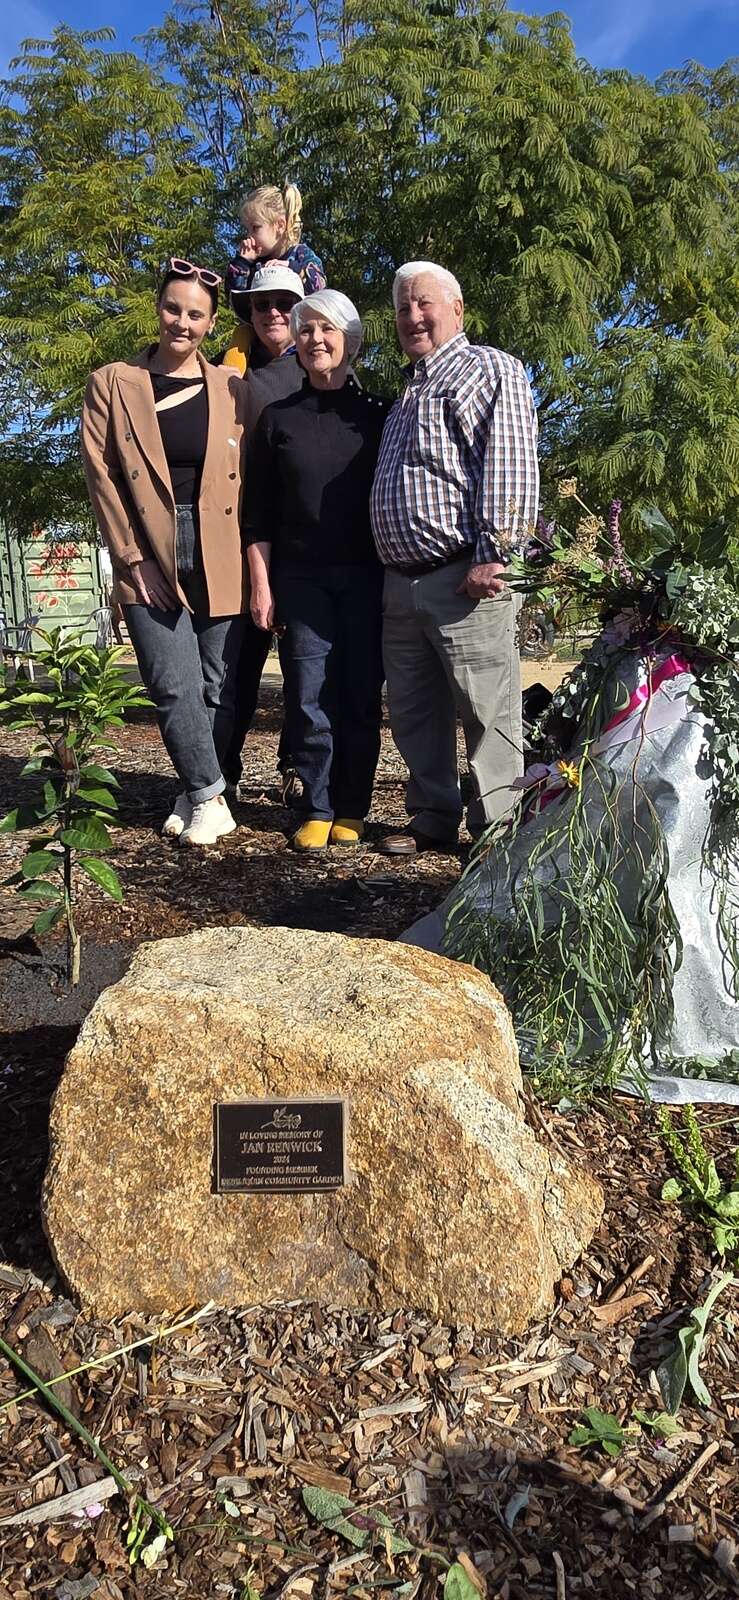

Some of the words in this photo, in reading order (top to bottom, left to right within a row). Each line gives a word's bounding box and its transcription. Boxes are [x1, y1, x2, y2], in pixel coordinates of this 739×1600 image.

[240, 1131, 248, 1140] IN
[249, 1130, 278, 1140] LOVING
[278, 1130, 312, 1139] MEMORY
[313, 1129, 324, 1138] OF
[241, 1141, 264, 1154] JAN
[267, 1140, 323, 1153] RENWICK
[246, 1166, 284, 1175] FOUNDING
[285, 1165, 318, 1174] MEMBER
[264, 1175, 312, 1185] COMMUNITY
[312, 1175, 343, 1184] GARDEN
